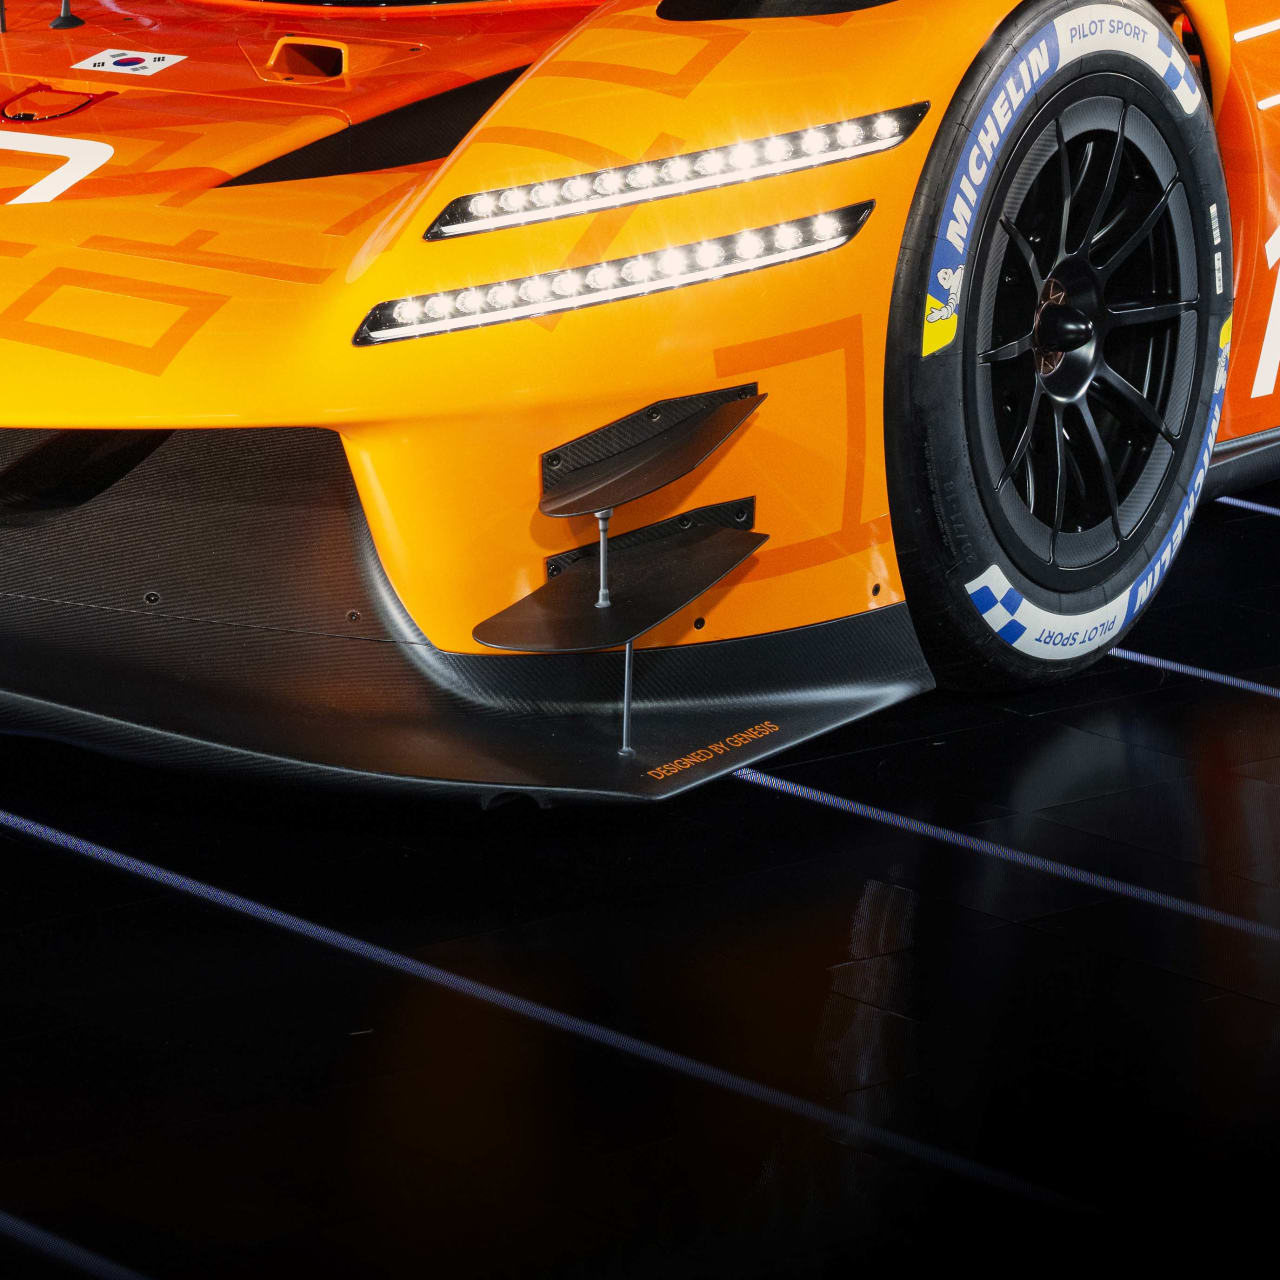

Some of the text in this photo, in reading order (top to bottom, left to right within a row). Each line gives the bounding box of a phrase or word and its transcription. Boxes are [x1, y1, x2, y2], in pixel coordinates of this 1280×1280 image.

[1070, 18, 1149, 45] PILOT SPORT
[945, 39, 1051, 254] MICHELIN
[1034, 615, 1117, 646] PILOT SPORT
[648, 721, 780, 779] DESIGNED BY GENESIS
